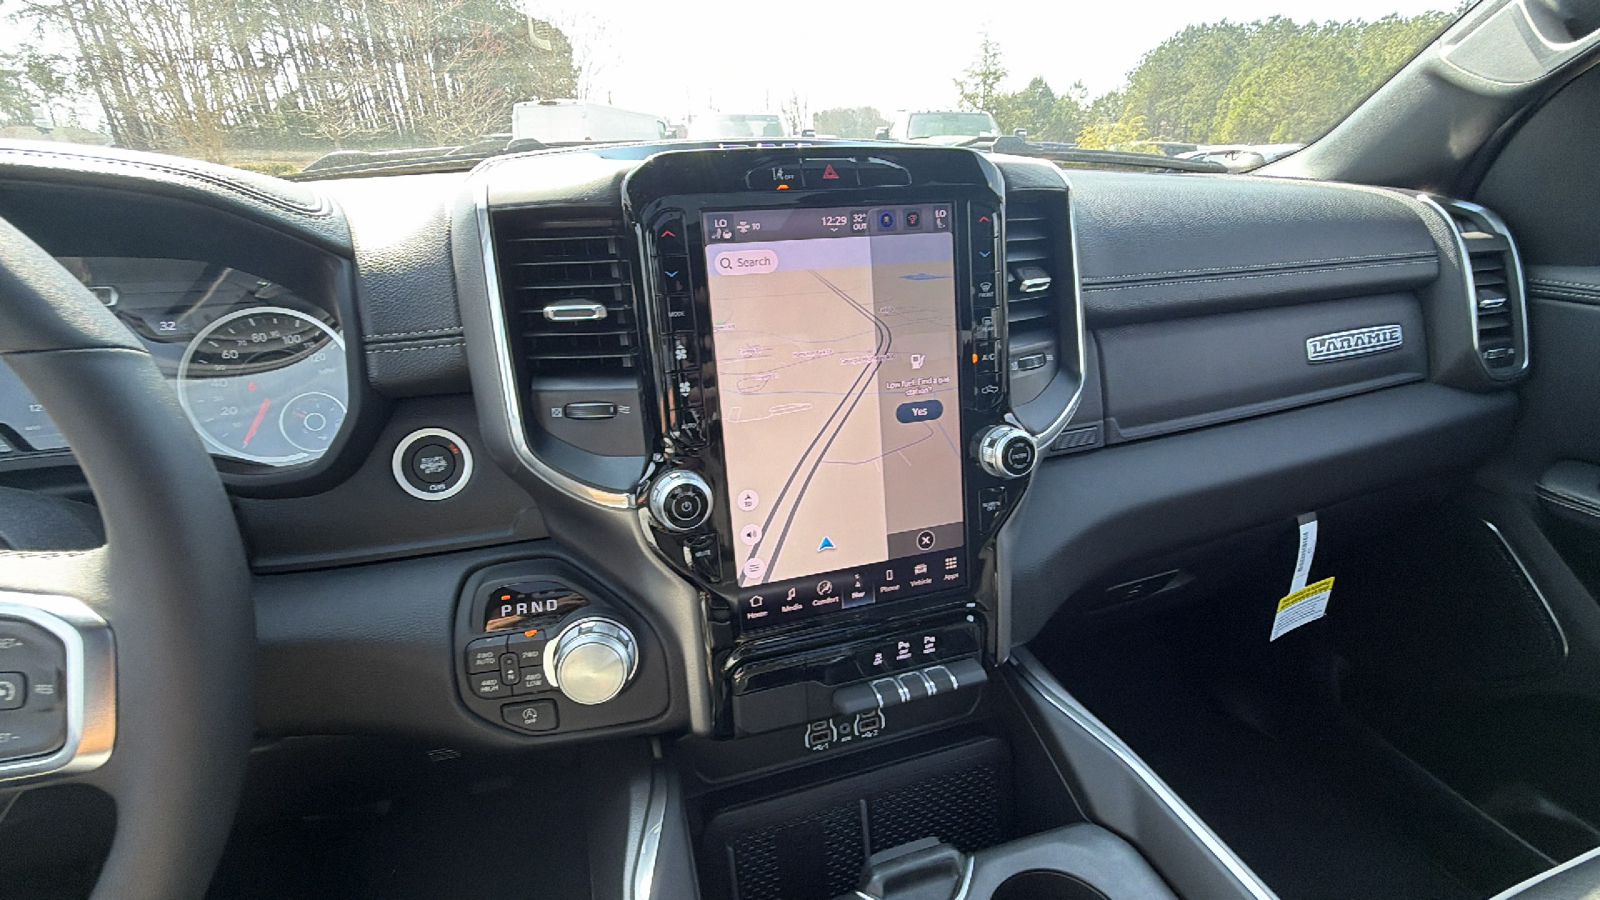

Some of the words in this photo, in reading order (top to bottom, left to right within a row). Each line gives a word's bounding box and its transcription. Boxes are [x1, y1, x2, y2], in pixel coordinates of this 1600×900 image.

[934, 209, 947, 218] LO
[714, 219, 728, 228] LO
[821, 215, 848, 226] 12:29
[751, 222, 761, 231] 10
[852, 222, 867, 231] OUT
[737, 256, 771, 268] Search
[668, 310, 685, 318] MODE
[159, 321, 177, 331] 32
[251, 332, 268, 343] 80
[282, 334, 301, 344] 100
[1311, 328, 1400, 354] LARAMIE
[221, 350, 239, 360] 60
[917, 377, 932, 386] Find
[938, 376, 950, 385] gas
[905, 386, 933, 396] station?
[220, 406, 238, 416] 20
[911, 407, 928, 417] Yes
[944, 572, 960, 581] Apps
[910, 576, 933, 588] Vehicle
[880, 583, 900, 594] Phone
[812, 595, 839, 607] Comfort
[781, 603, 803, 613] Media
[747, 611, 768, 620] Home
